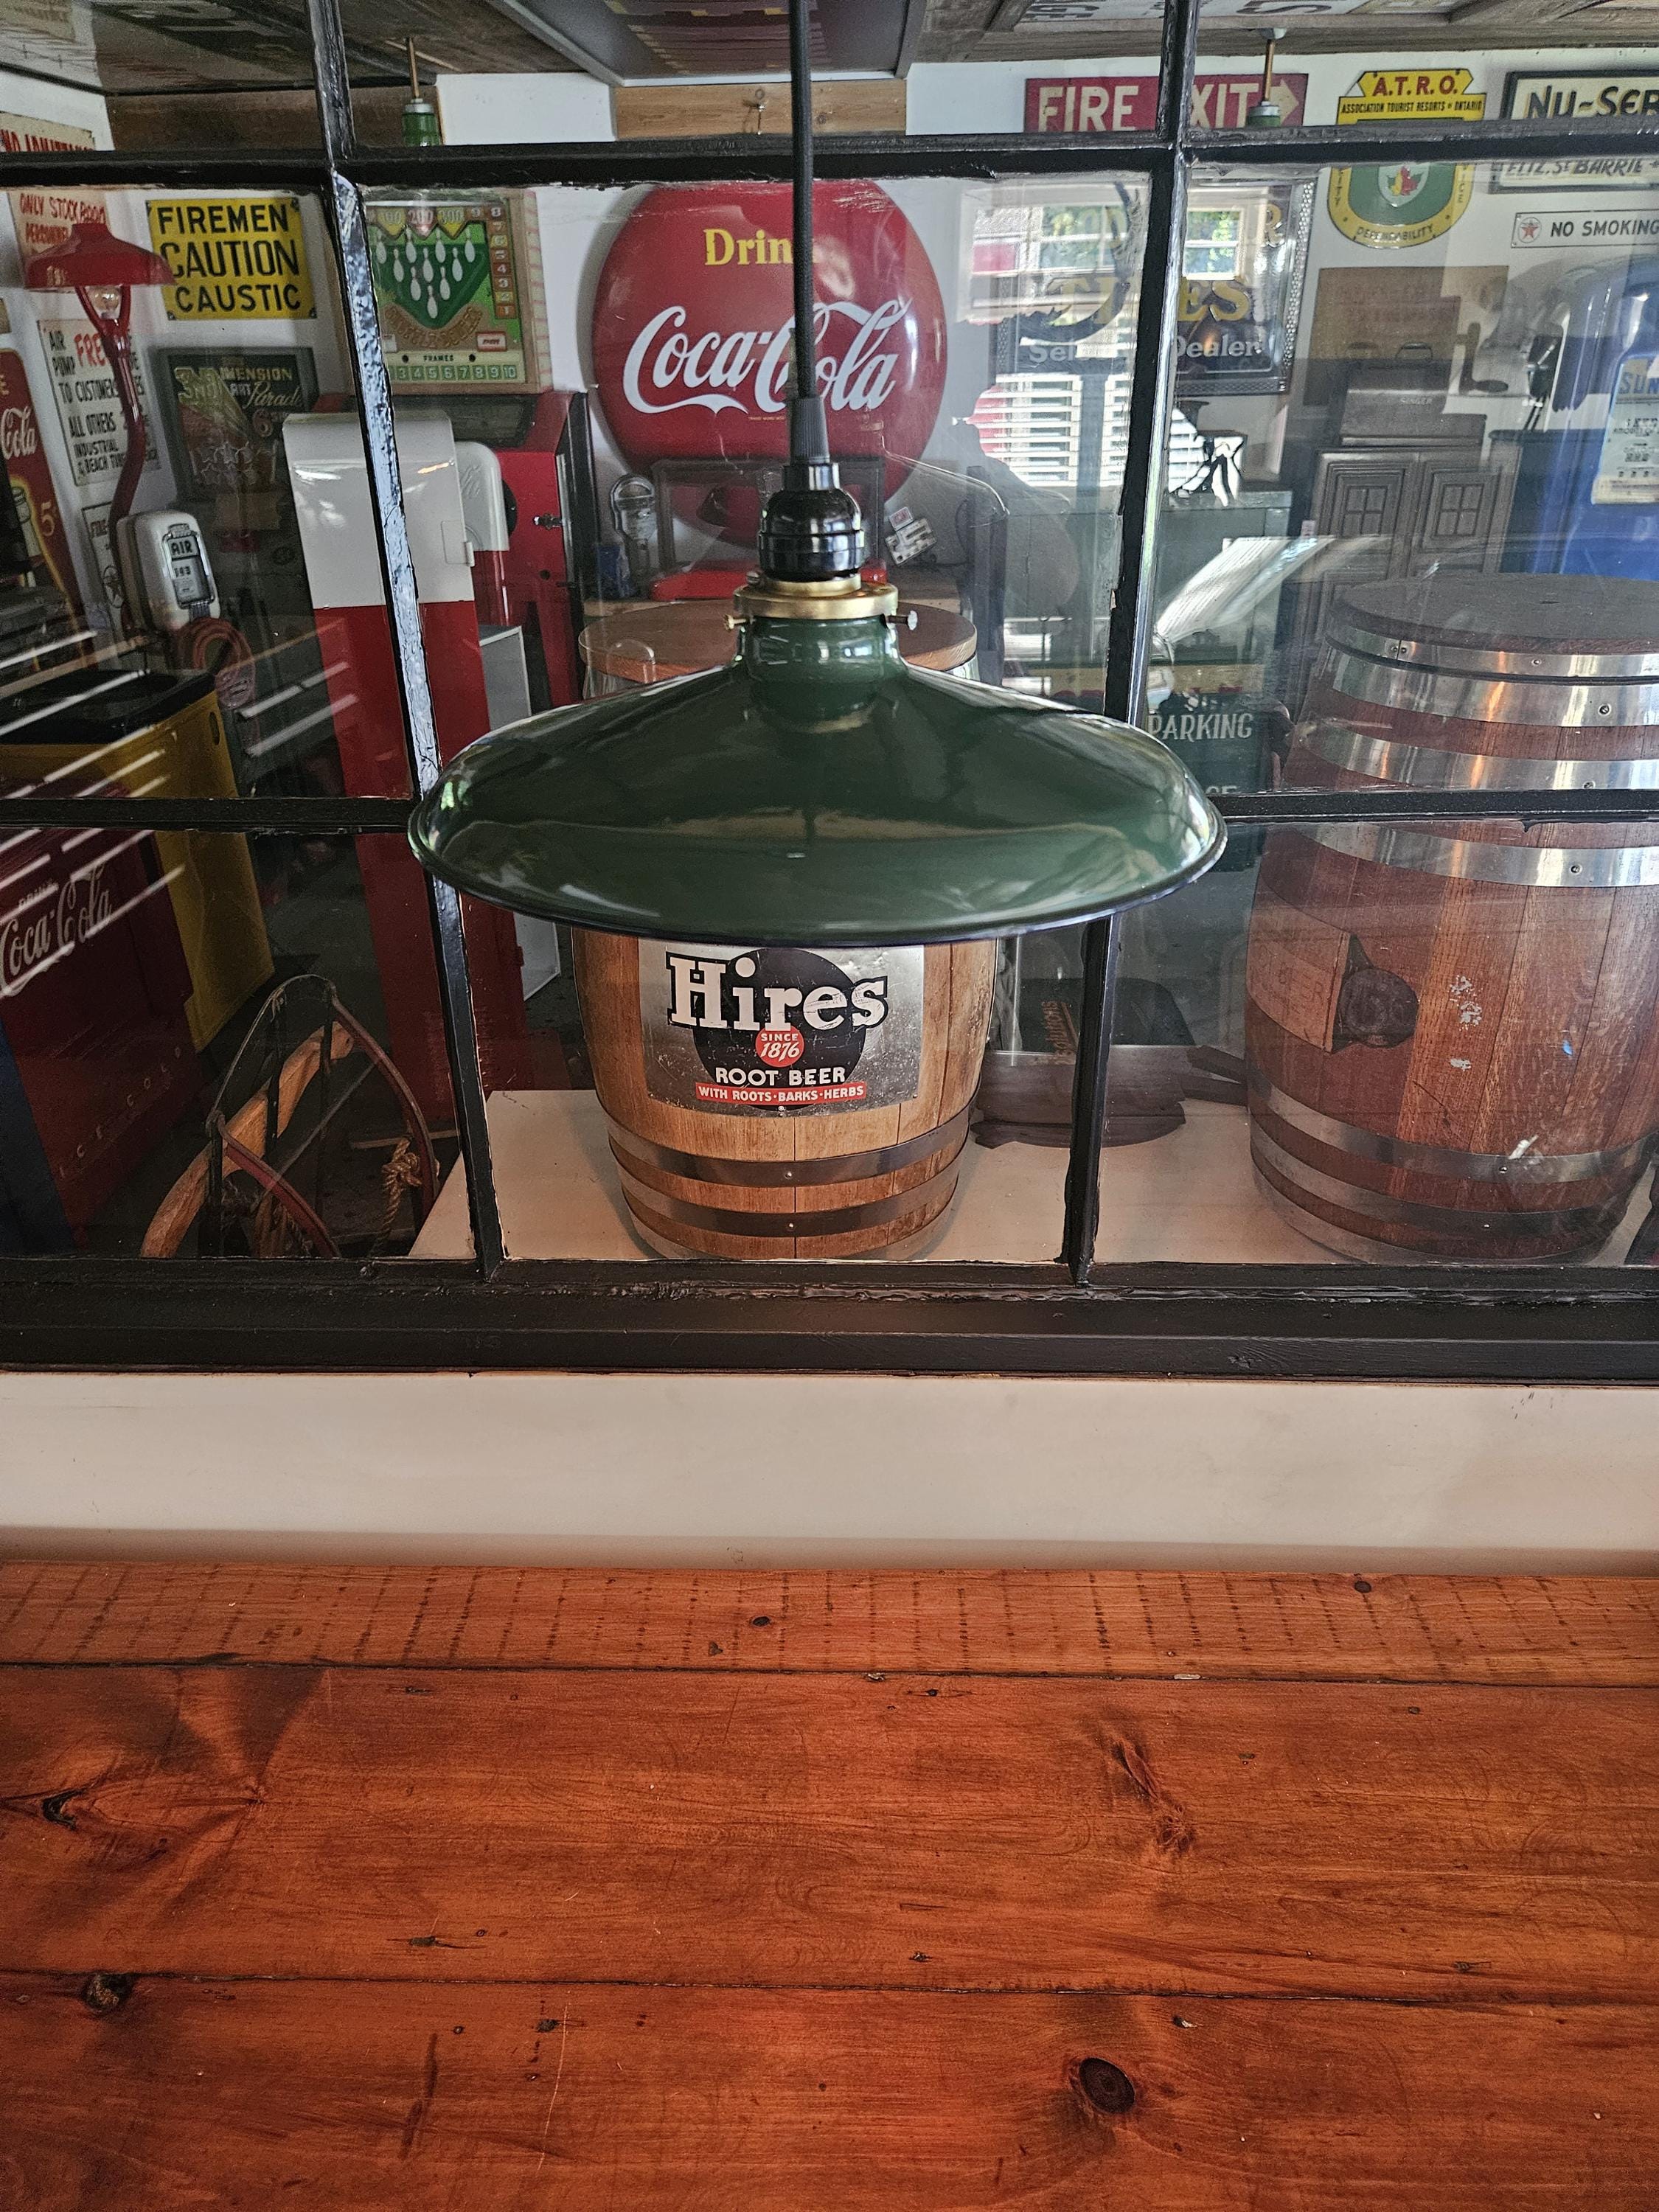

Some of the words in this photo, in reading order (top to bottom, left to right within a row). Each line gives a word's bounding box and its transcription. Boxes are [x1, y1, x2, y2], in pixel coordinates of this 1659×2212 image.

[1372, 75, 1458, 97] A.T.R.O.
[1038, 85, 1140, 133] FIRE
[1191, 83, 1260, 130] XIT
[1341, 102, 1385, 114] ASSOCIATION
[1387, 100, 1414, 112] TOURIST
[1416, 100, 1445, 112] RESORTS
[1455, 99, 1483, 111] ONTARIO
[1573, 158, 1644, 176] BARRIE
[20, 192, 45, 217] ONLY
[491, 206, 501, 218] 8
[157, 204, 290, 234] FIREMEN
[1551, 221, 1575, 237] NO
[1582, 219, 1659, 237] SMOKING
[703, 228, 800, 266] Drin
[159, 240, 299, 278] CAUTION
[175, 284, 300, 313] CAUSTIC
[623, 297, 912, 414] Coca-Cola
[504, 366, 515, 378] 10
[58, 382, 73, 404] TO
[68, 415, 86, 438] ALL
[170, 540, 193, 554] AIR
[1147, 712, 1253, 743] PARKING
[667, 953, 888, 1032] Hires
[760, 1032, 799, 1042] SINCE
[759, 1042, 801, 1062] 1876
[715, 1067, 779, 1086] ROOT
[788, 1066, 846, 1086] BEER
[698, 1085, 728, 1100] WITH
